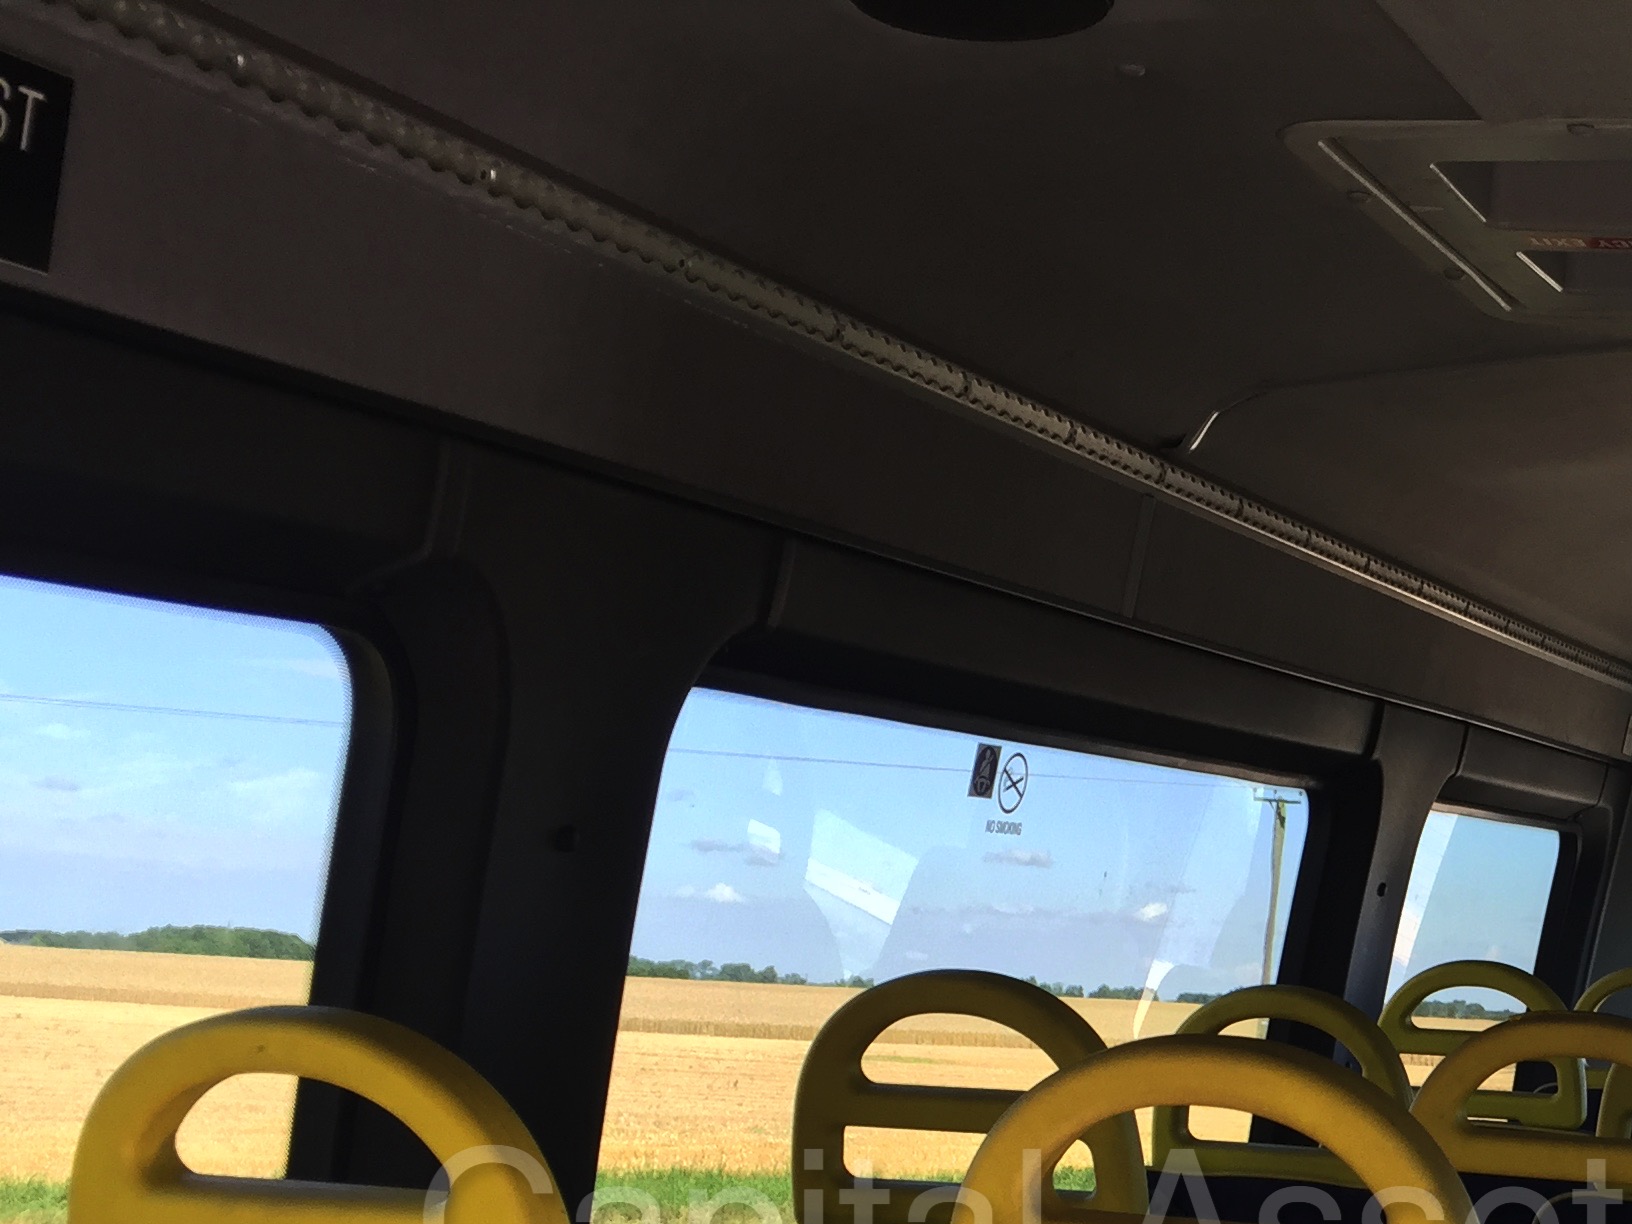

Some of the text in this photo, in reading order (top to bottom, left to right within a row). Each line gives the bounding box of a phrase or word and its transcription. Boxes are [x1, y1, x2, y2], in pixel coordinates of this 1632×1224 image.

[1530, 237, 1587, 248] EXIT
[985, 819, 1022, 836] NO SMOKING
